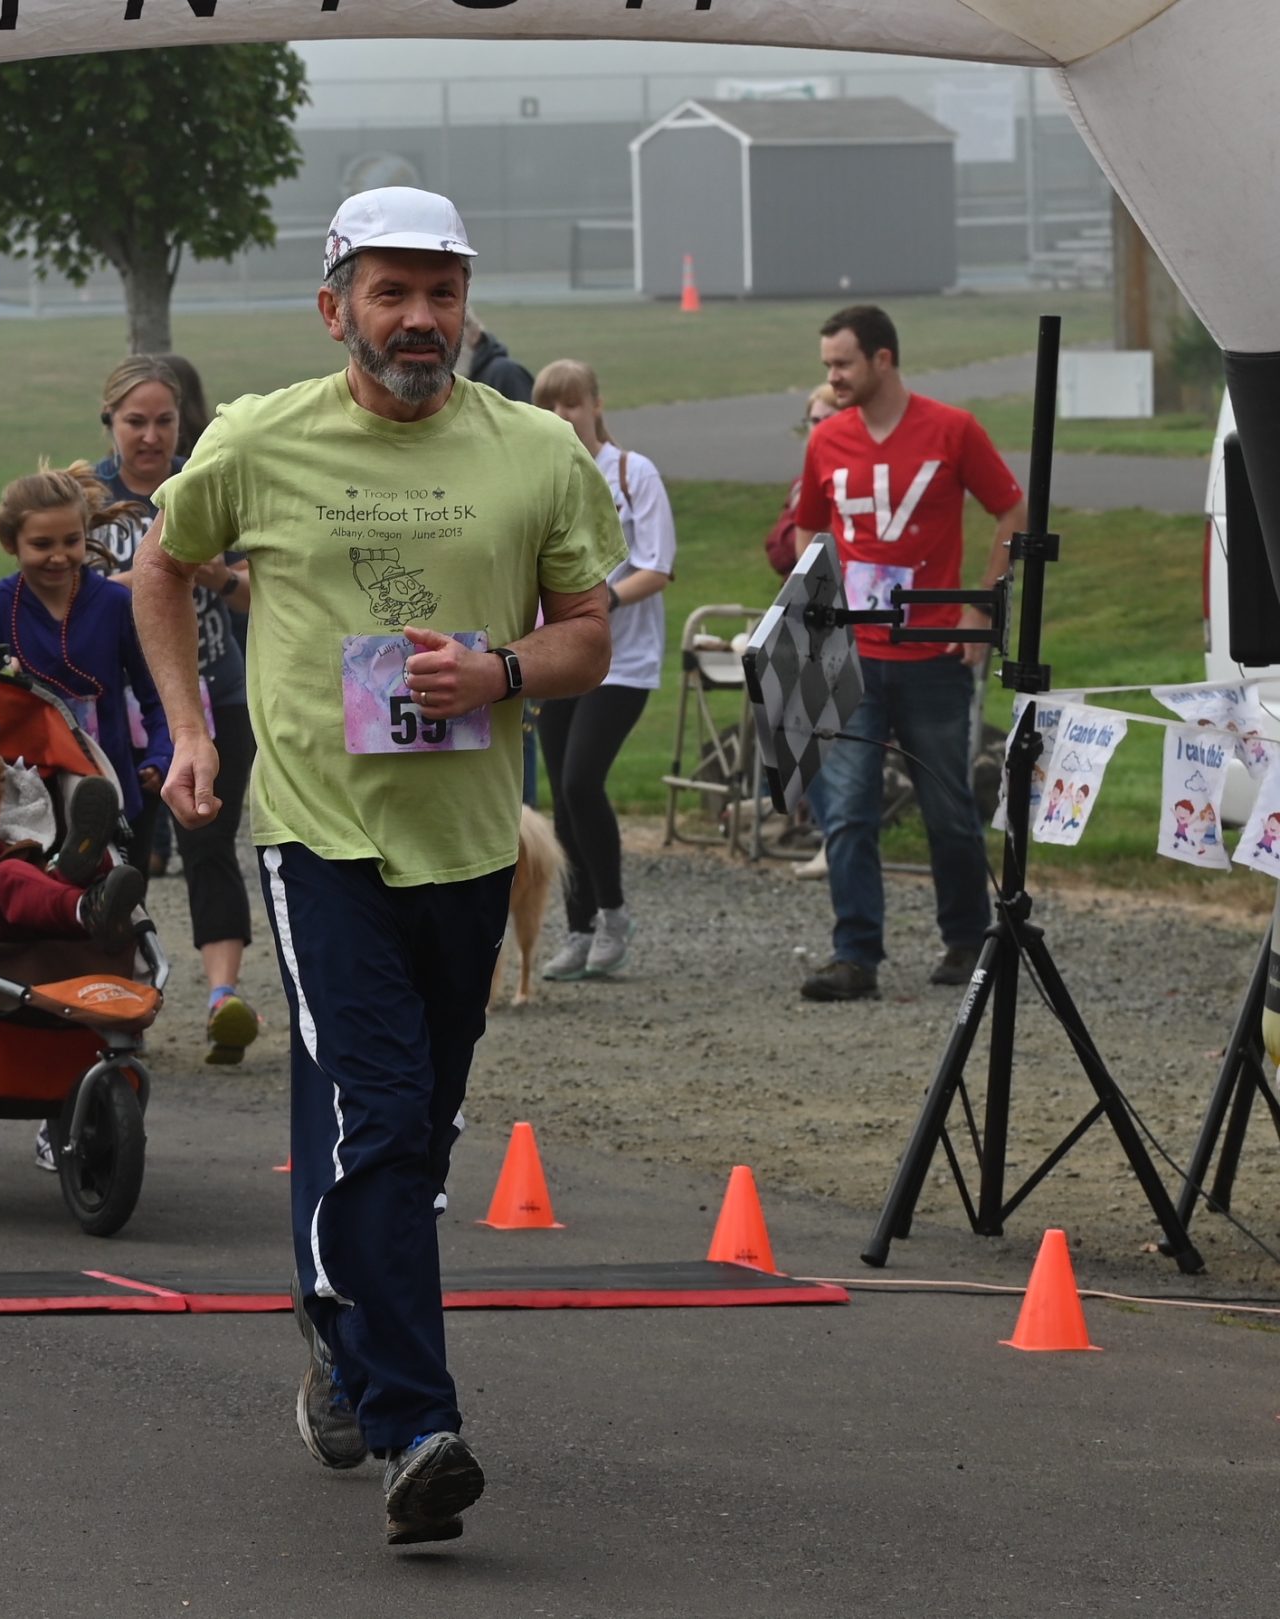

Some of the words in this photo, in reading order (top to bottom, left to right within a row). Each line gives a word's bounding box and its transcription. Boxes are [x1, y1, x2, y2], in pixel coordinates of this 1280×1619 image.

[363, 488, 398, 501] Troop
[404, 489, 428, 500] 100
[315, 503, 409, 522] Tenderfoot
[413, 505, 449, 522] Trot
[453, 504, 477, 520] 5K
[330, 527, 365, 540] Albany,
[367, 528, 402, 541] Oregon
[411, 529, 436, 541] June
[438, 527, 463, 538] 2013
